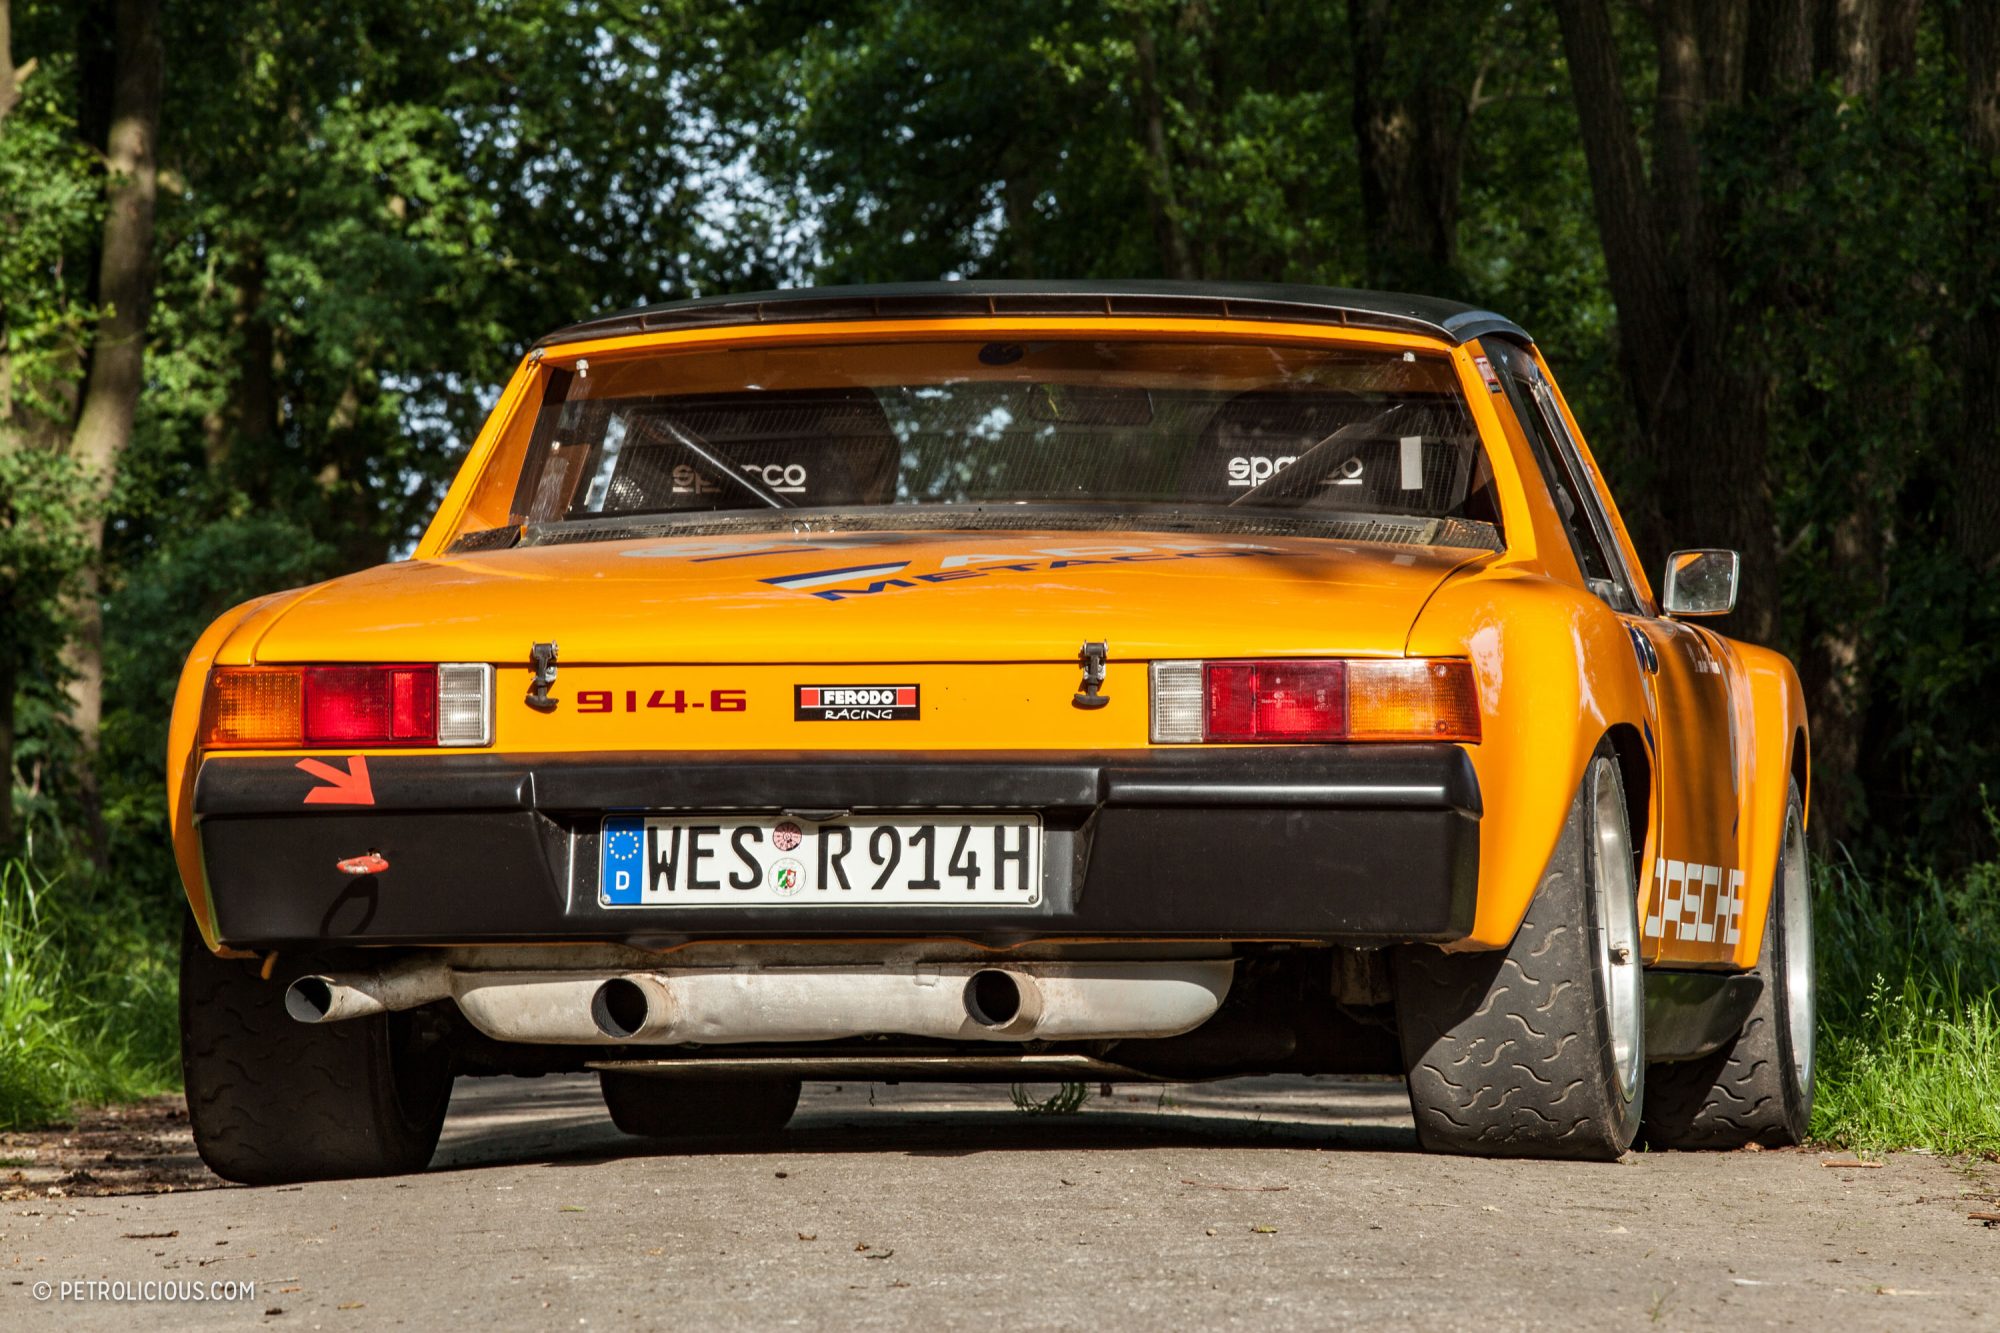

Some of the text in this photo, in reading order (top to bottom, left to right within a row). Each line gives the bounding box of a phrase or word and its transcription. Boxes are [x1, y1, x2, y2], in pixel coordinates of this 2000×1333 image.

[672, 464, 806, 494] spco
[577, 690, 746, 713] 914-6
[824, 690, 894, 705] FERODO
[825, 708, 893, 720] RACING
[647, 826, 764, 891] WES
[616, 871, 630, 890] D
[1645, 857, 1745, 944] ORSCHE
